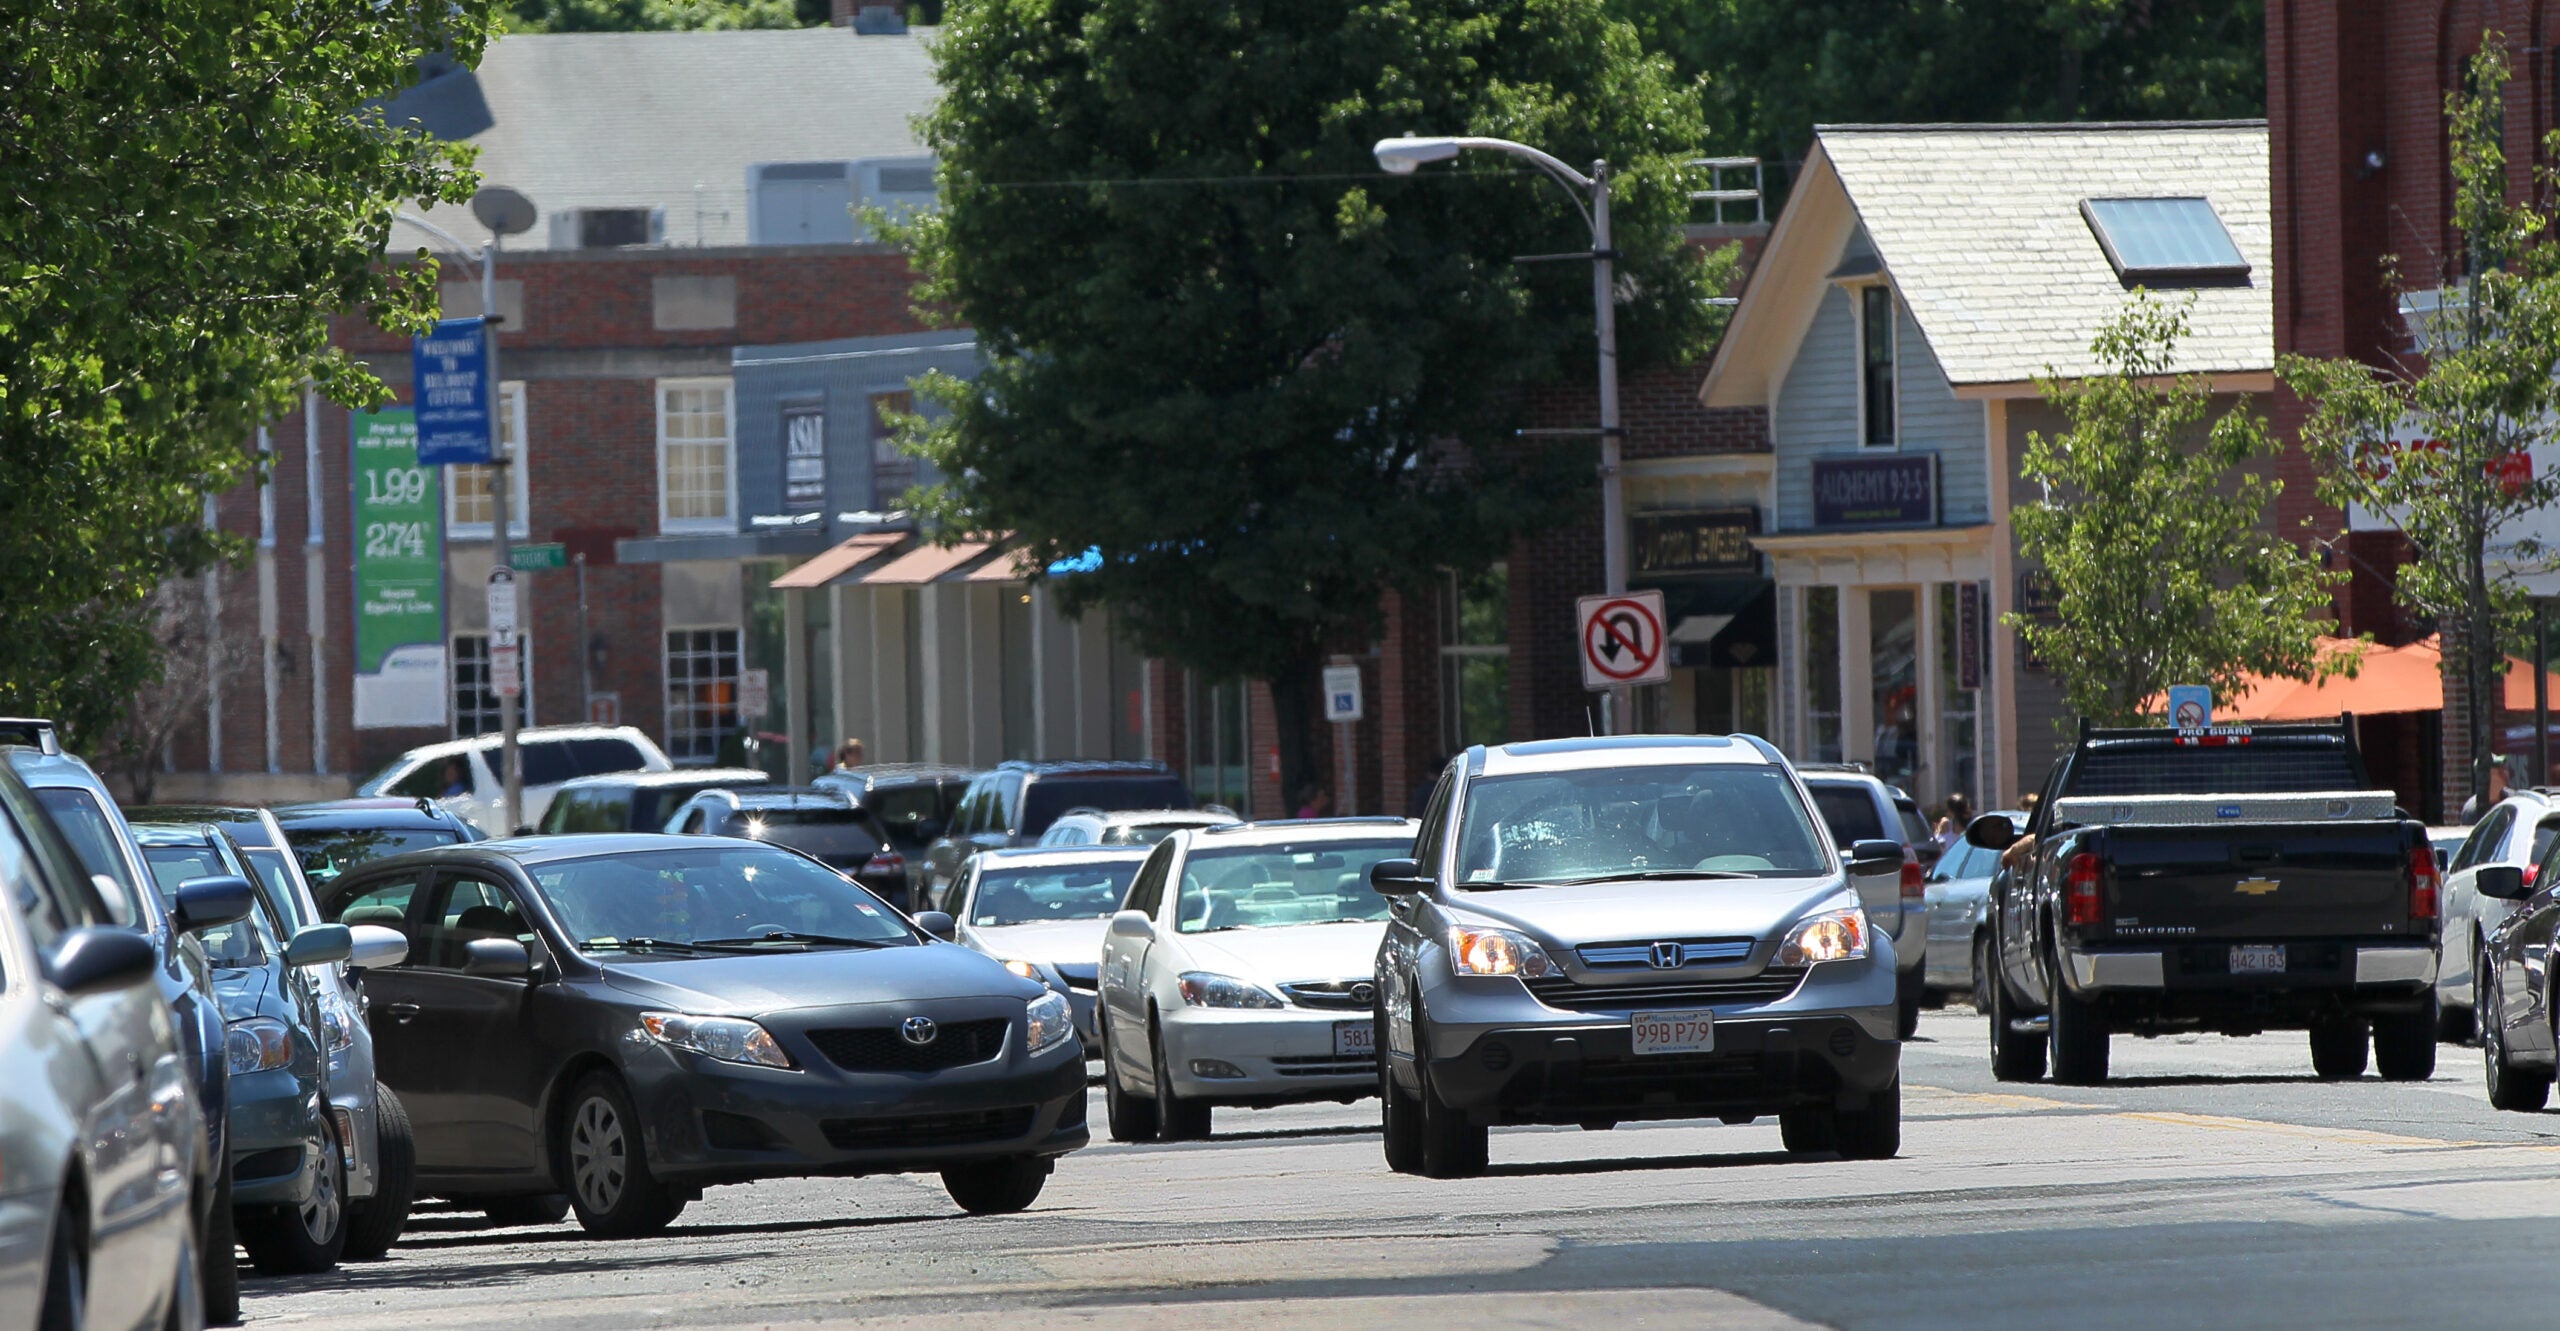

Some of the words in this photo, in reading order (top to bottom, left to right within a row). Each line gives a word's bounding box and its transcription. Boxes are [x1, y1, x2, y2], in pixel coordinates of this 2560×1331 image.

[1822, 469, 1887, 507] ALCHEMY
[2178, 727, 2205, 737] PRO
[2209, 726, 2253, 736] GUARD
[2115, 926, 2196, 936] SILVERADO
[1343, 1029, 1375, 1047] 581
[1636, 1022, 1671, 1044] 99B
[1675, 1021, 1709, 1043] P79
